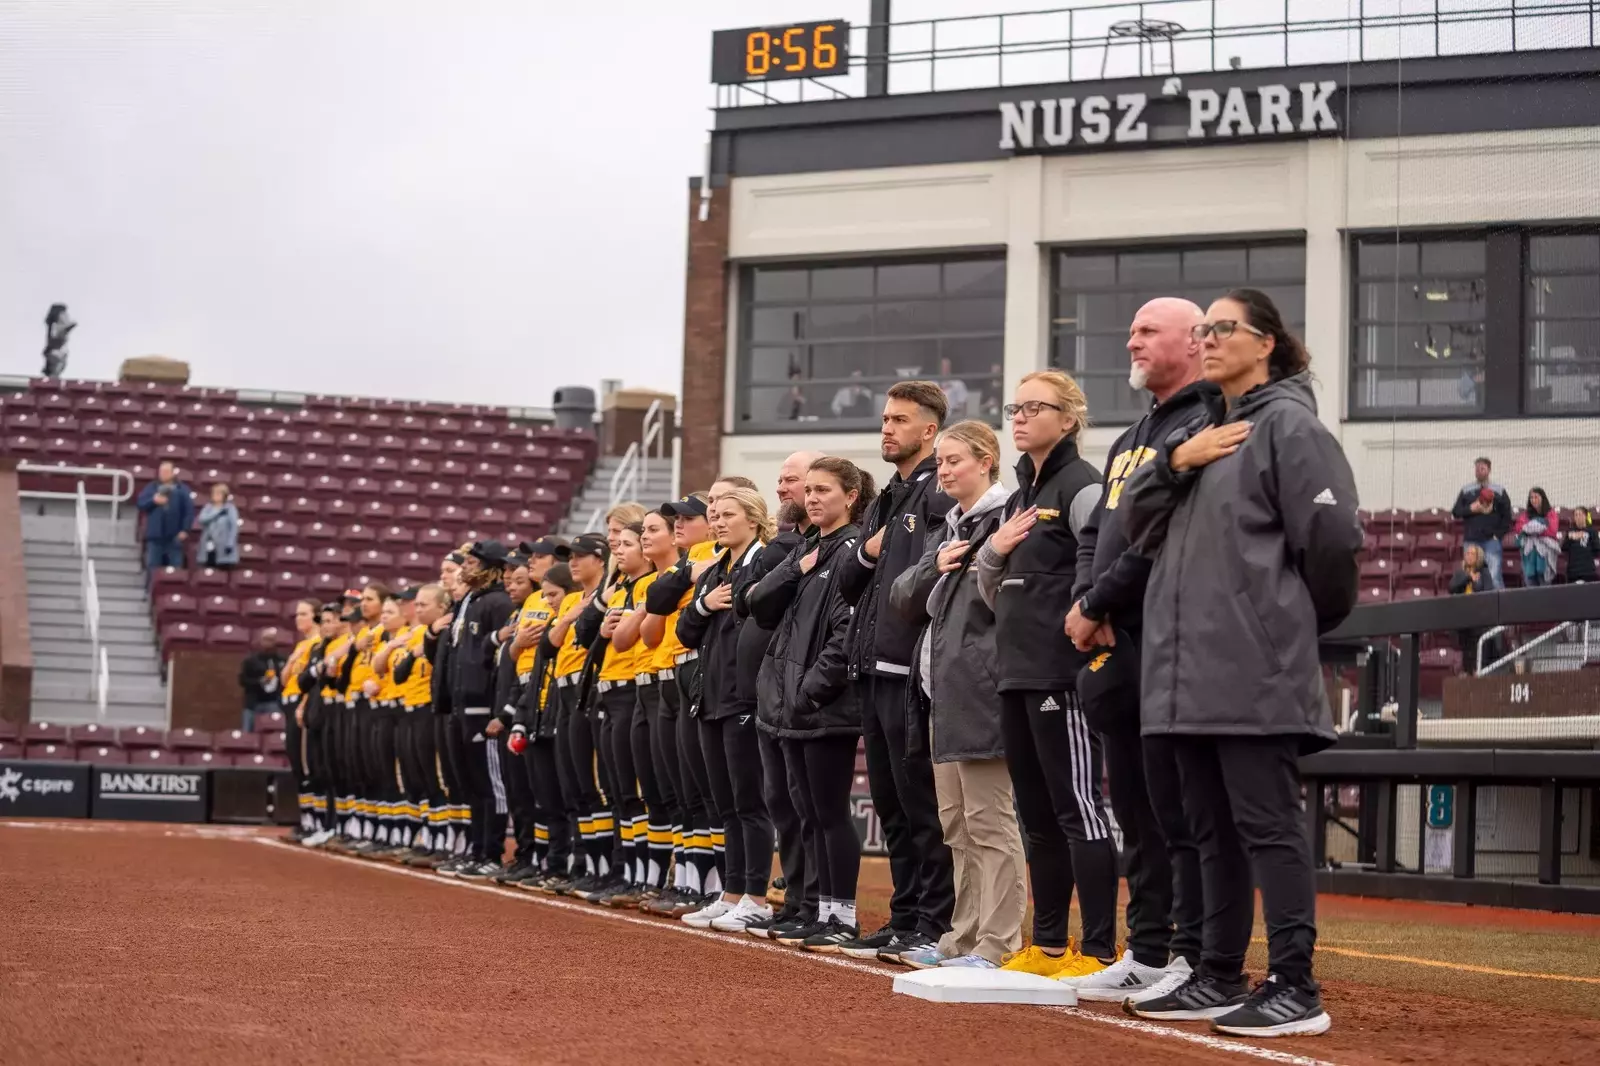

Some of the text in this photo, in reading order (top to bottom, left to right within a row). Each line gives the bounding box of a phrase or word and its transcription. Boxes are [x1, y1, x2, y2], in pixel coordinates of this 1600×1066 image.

[746, 24, 837, 75] 8:56
[999, 80, 1337, 149] NUSZ PARK
[1510, 683, 1530, 703] 104
[34, 778, 75, 795] spire
[100, 773, 201, 793] BANKFIRST
[1427, 783, 1453, 829] 8
